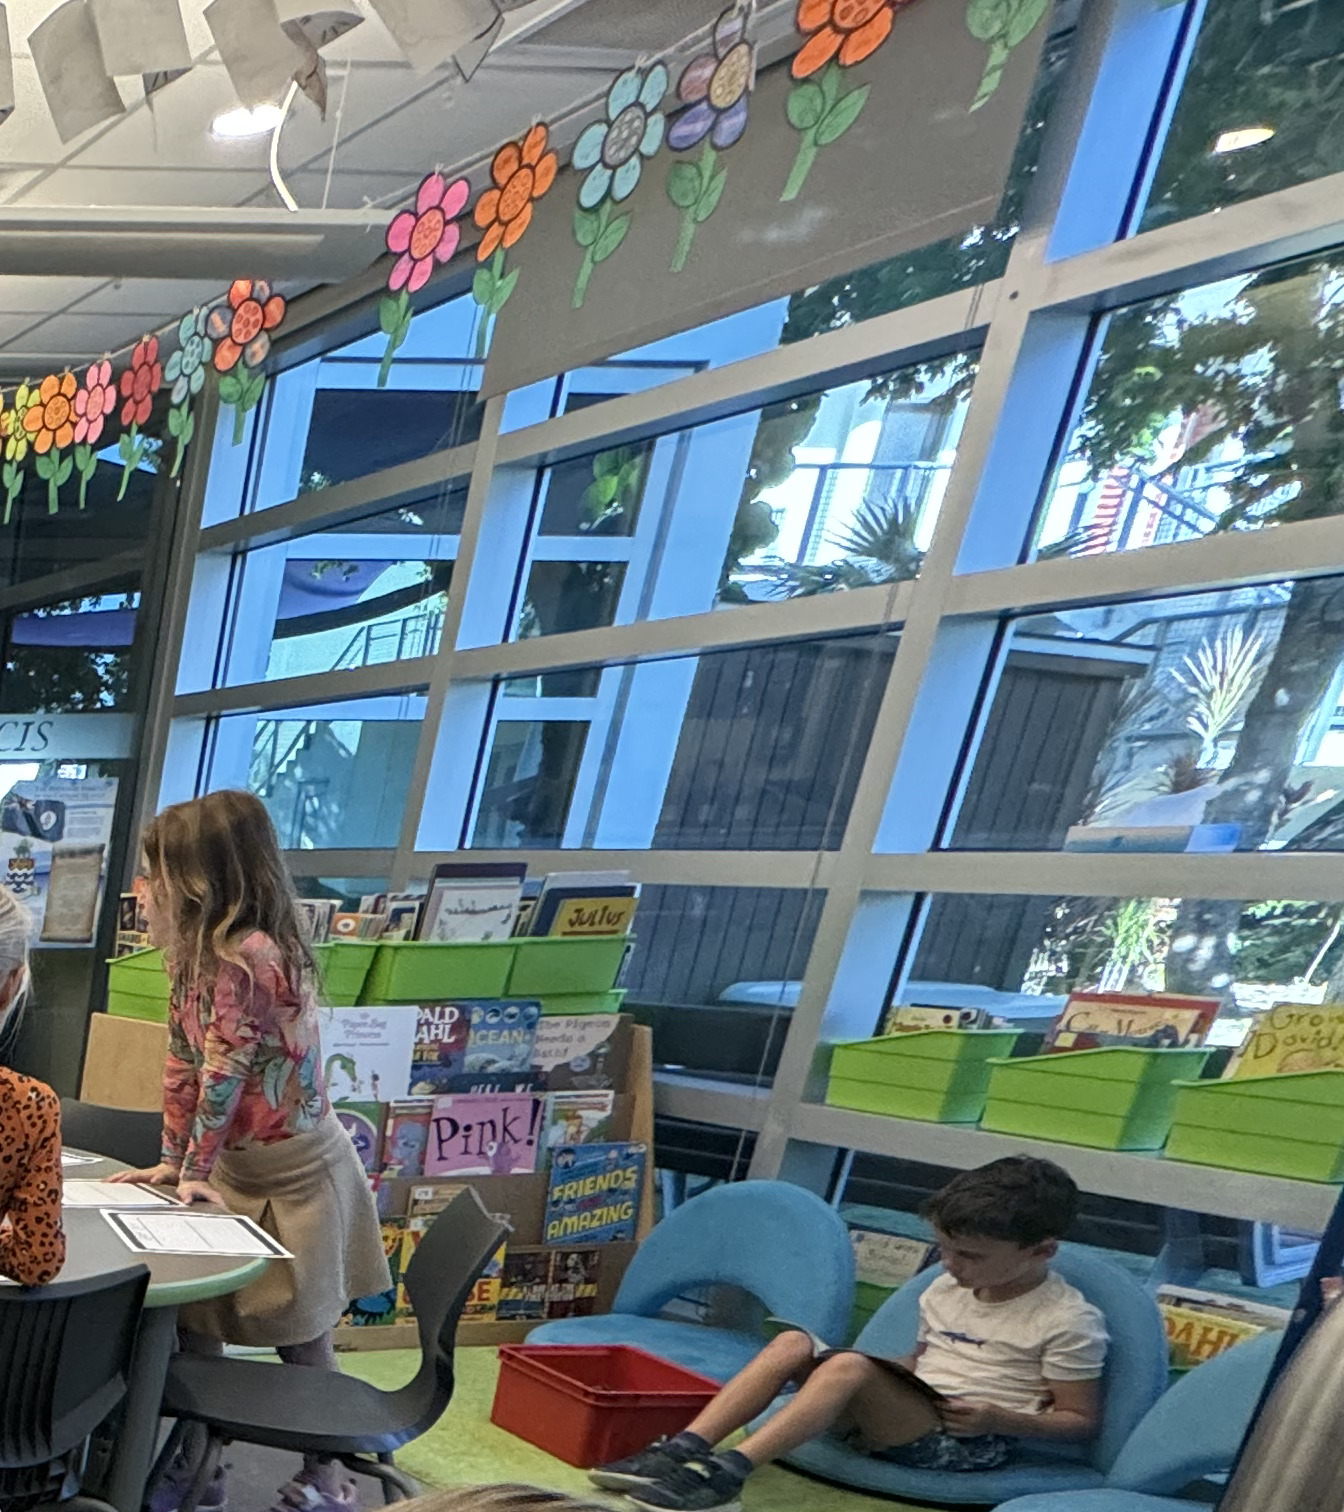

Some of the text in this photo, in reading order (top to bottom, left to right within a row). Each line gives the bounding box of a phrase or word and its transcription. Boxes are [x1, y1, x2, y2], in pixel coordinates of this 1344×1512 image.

[432, 1098, 544, 1162] Pink!
[552, 1165, 638, 1202] FRIENDS
[545, 1200, 635, 1240] AMAZING
